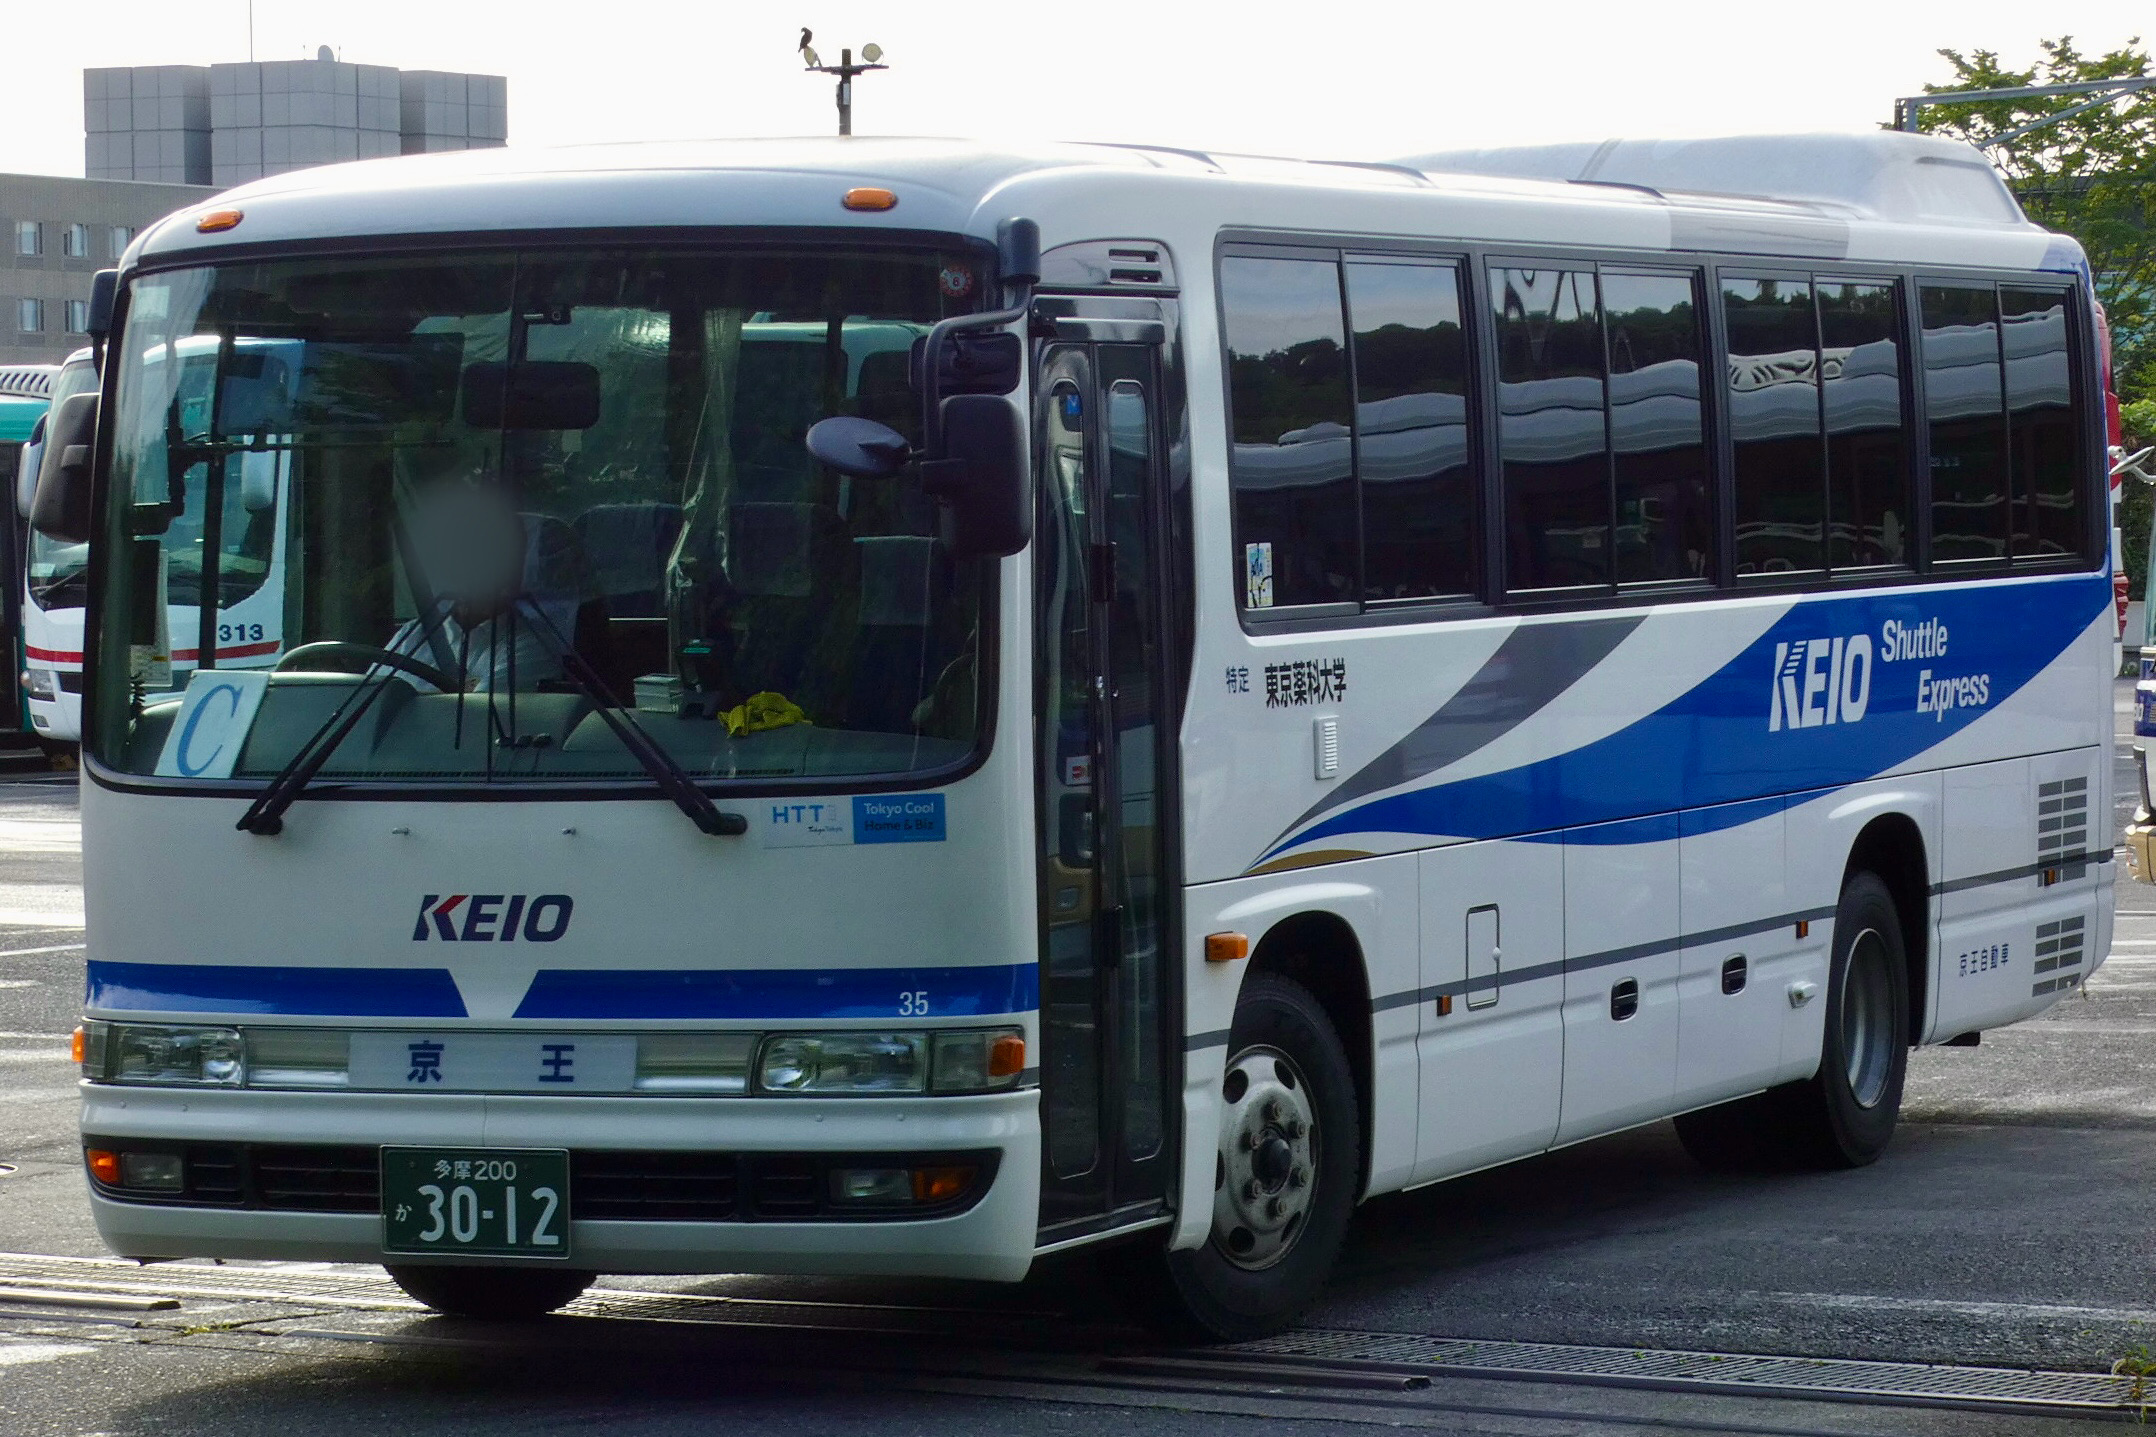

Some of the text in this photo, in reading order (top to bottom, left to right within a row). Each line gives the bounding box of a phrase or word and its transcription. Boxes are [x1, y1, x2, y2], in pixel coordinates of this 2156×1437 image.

[218, 623, 264, 642] 313
[1881, 617, 1948, 663] Shuttle
[1226, 657, 1347, 709] 特定 東京薬科大学
[1769, 634, 1873, 732] KEIO
[1916, 669, 1990, 723] Express
[176, 684, 245, 777] C
[772, 804, 825, 824] HTT
[864, 802, 935, 818] Tokyo Cool
[864, 820, 901, 832] Home
[915, 818, 934, 831] Biz
[412, 894, 575, 943] KEIO
[1959, 943, 2009, 978] 京王自動車
[899, 991, 929, 1016] 35
